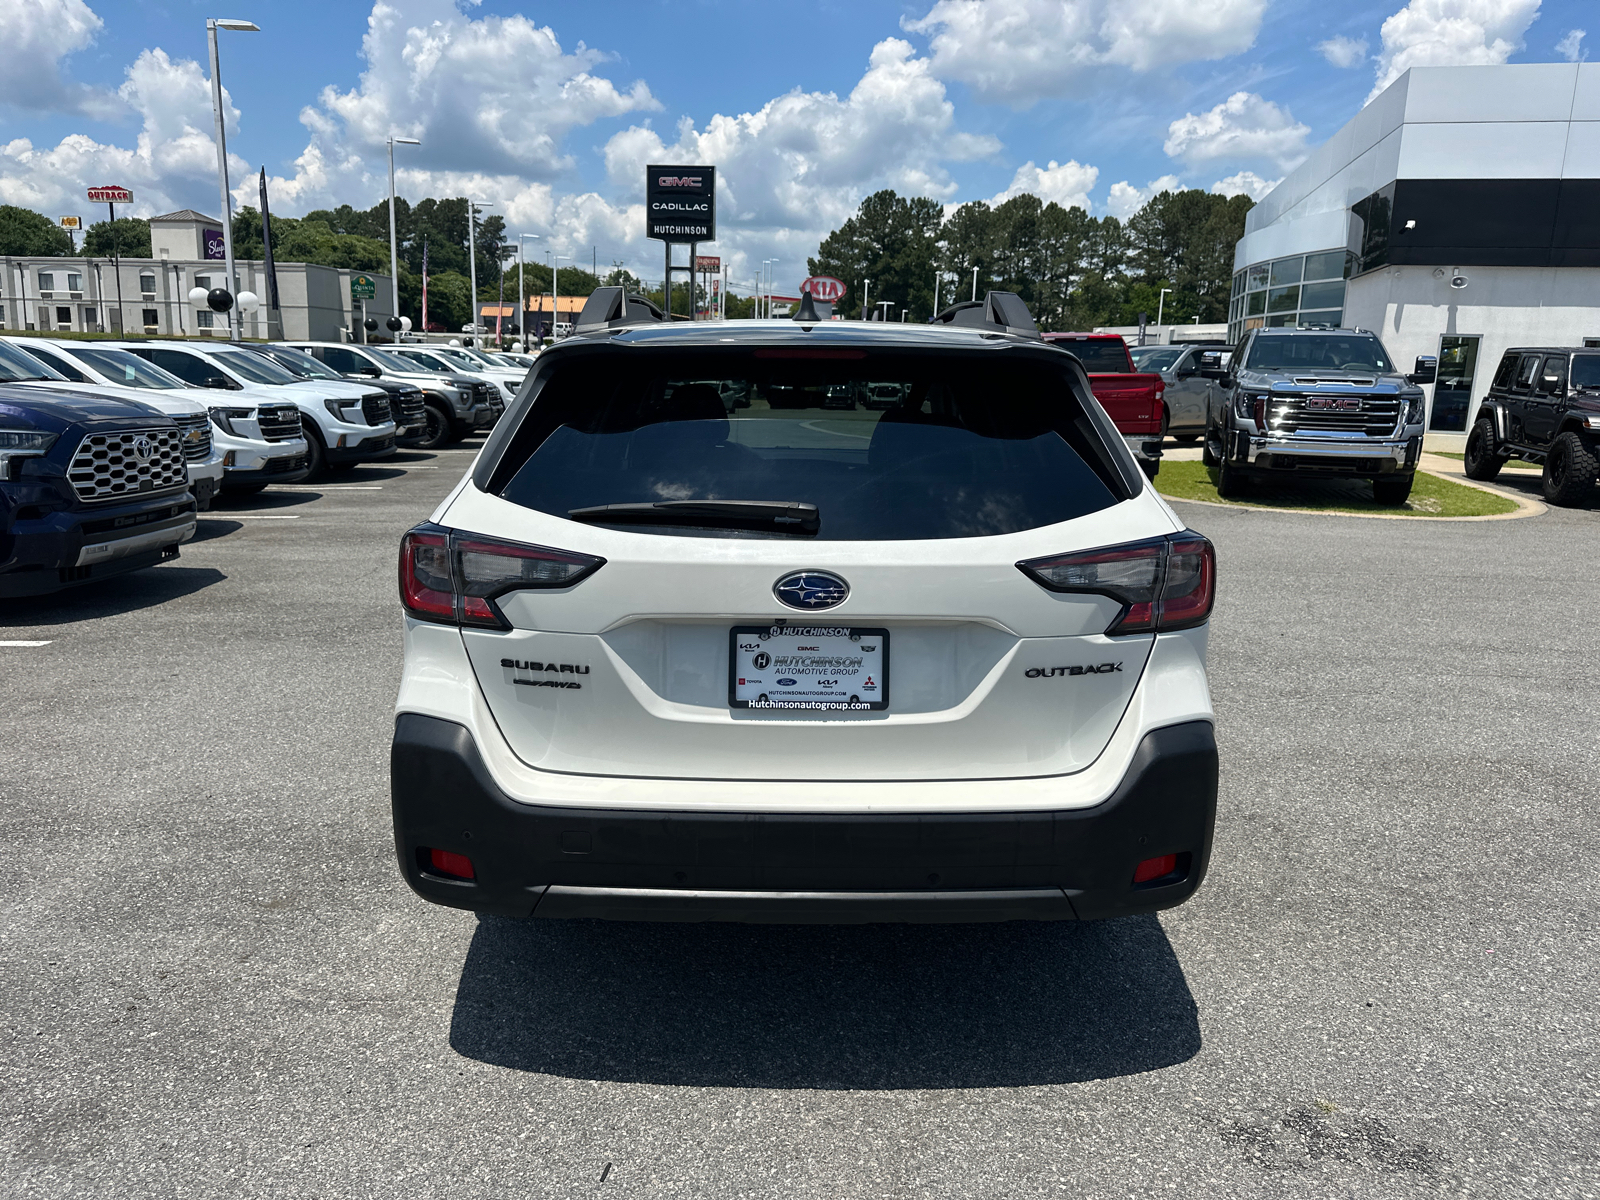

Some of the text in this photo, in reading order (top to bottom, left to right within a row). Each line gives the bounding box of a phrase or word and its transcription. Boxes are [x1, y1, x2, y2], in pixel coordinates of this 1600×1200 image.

[659, 176, 702, 187] GMC
[88, 191, 128, 200] OUTBACK
[652, 202, 708, 211] CADILLAC
[654, 225, 707, 234] HUTCHINSON
[810, 282, 839, 300] KIA
[1310, 399, 1358, 408] GMC
[782, 627, 850, 637] HUTCHINSON
[500, 658, 590, 674] SUBARU
[773, 656, 863, 668] HUTCHINSON
[1025, 662, 1123, 678] OUTBACK
[748, 700, 870, 710] Hutchinsonautogroup.com
